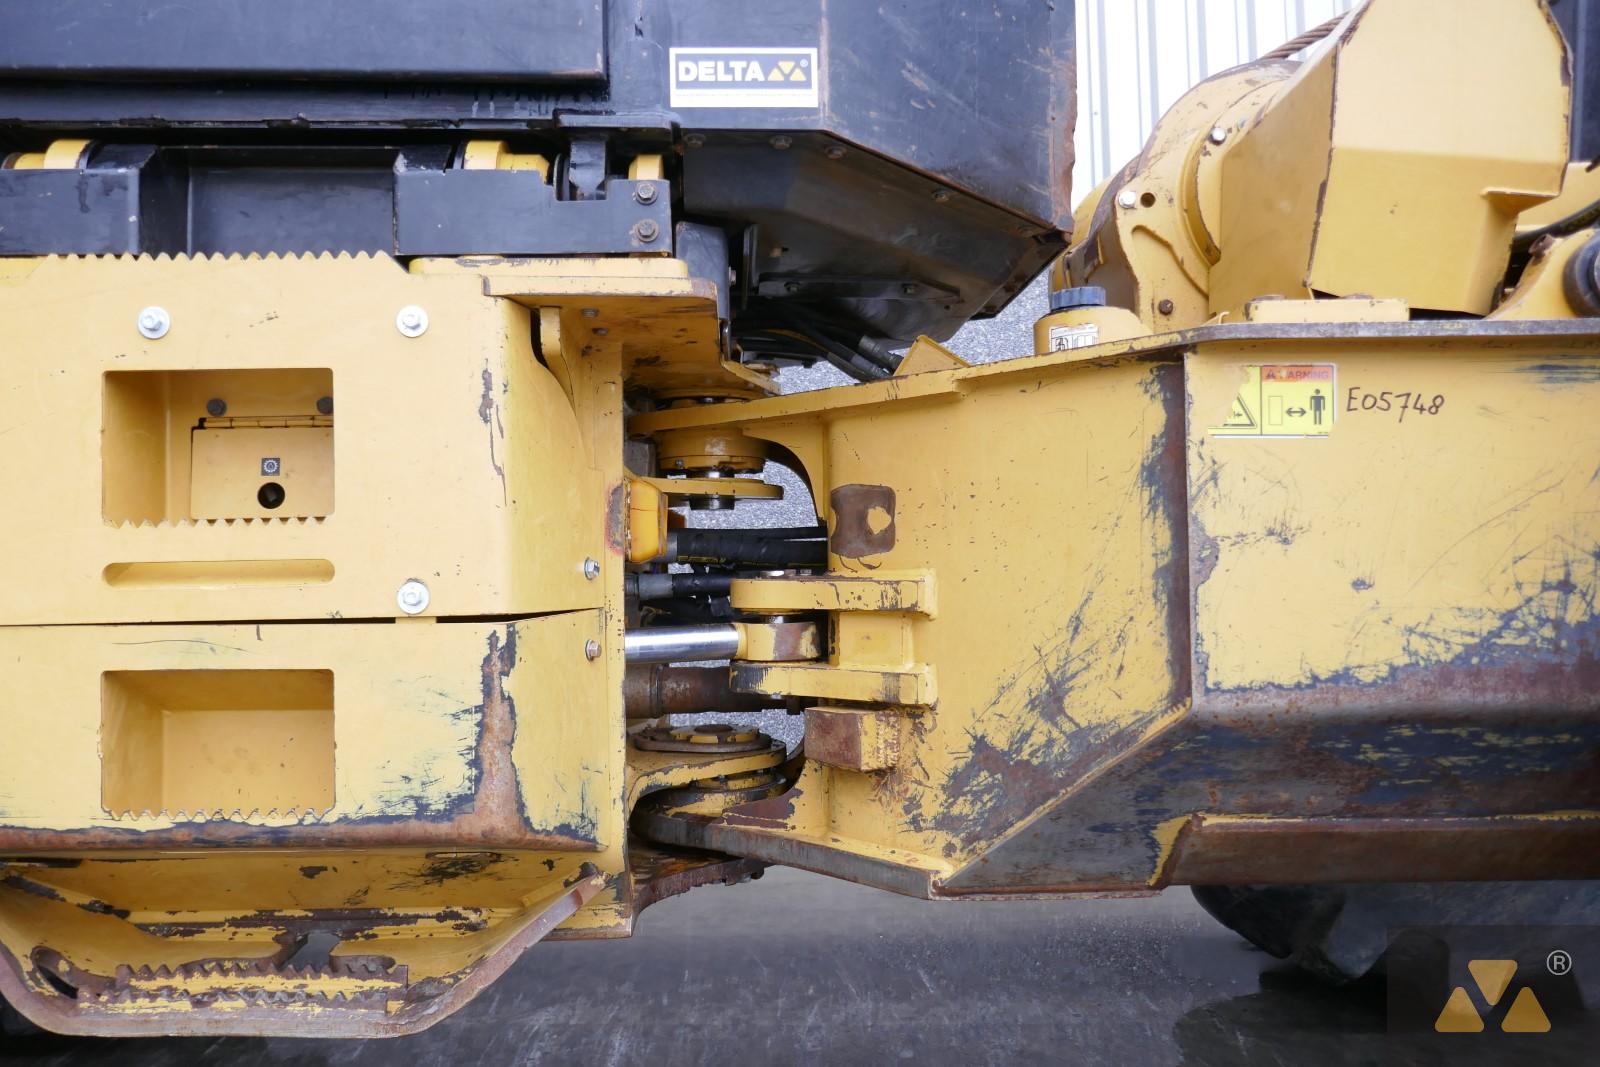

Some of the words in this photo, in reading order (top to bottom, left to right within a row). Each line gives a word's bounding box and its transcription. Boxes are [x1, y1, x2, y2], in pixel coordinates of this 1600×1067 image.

[678, 60, 766, 82] DELTA
[1280, 370, 1329, 379] ARNING
[1346, 386, 1445, 423] E05748
